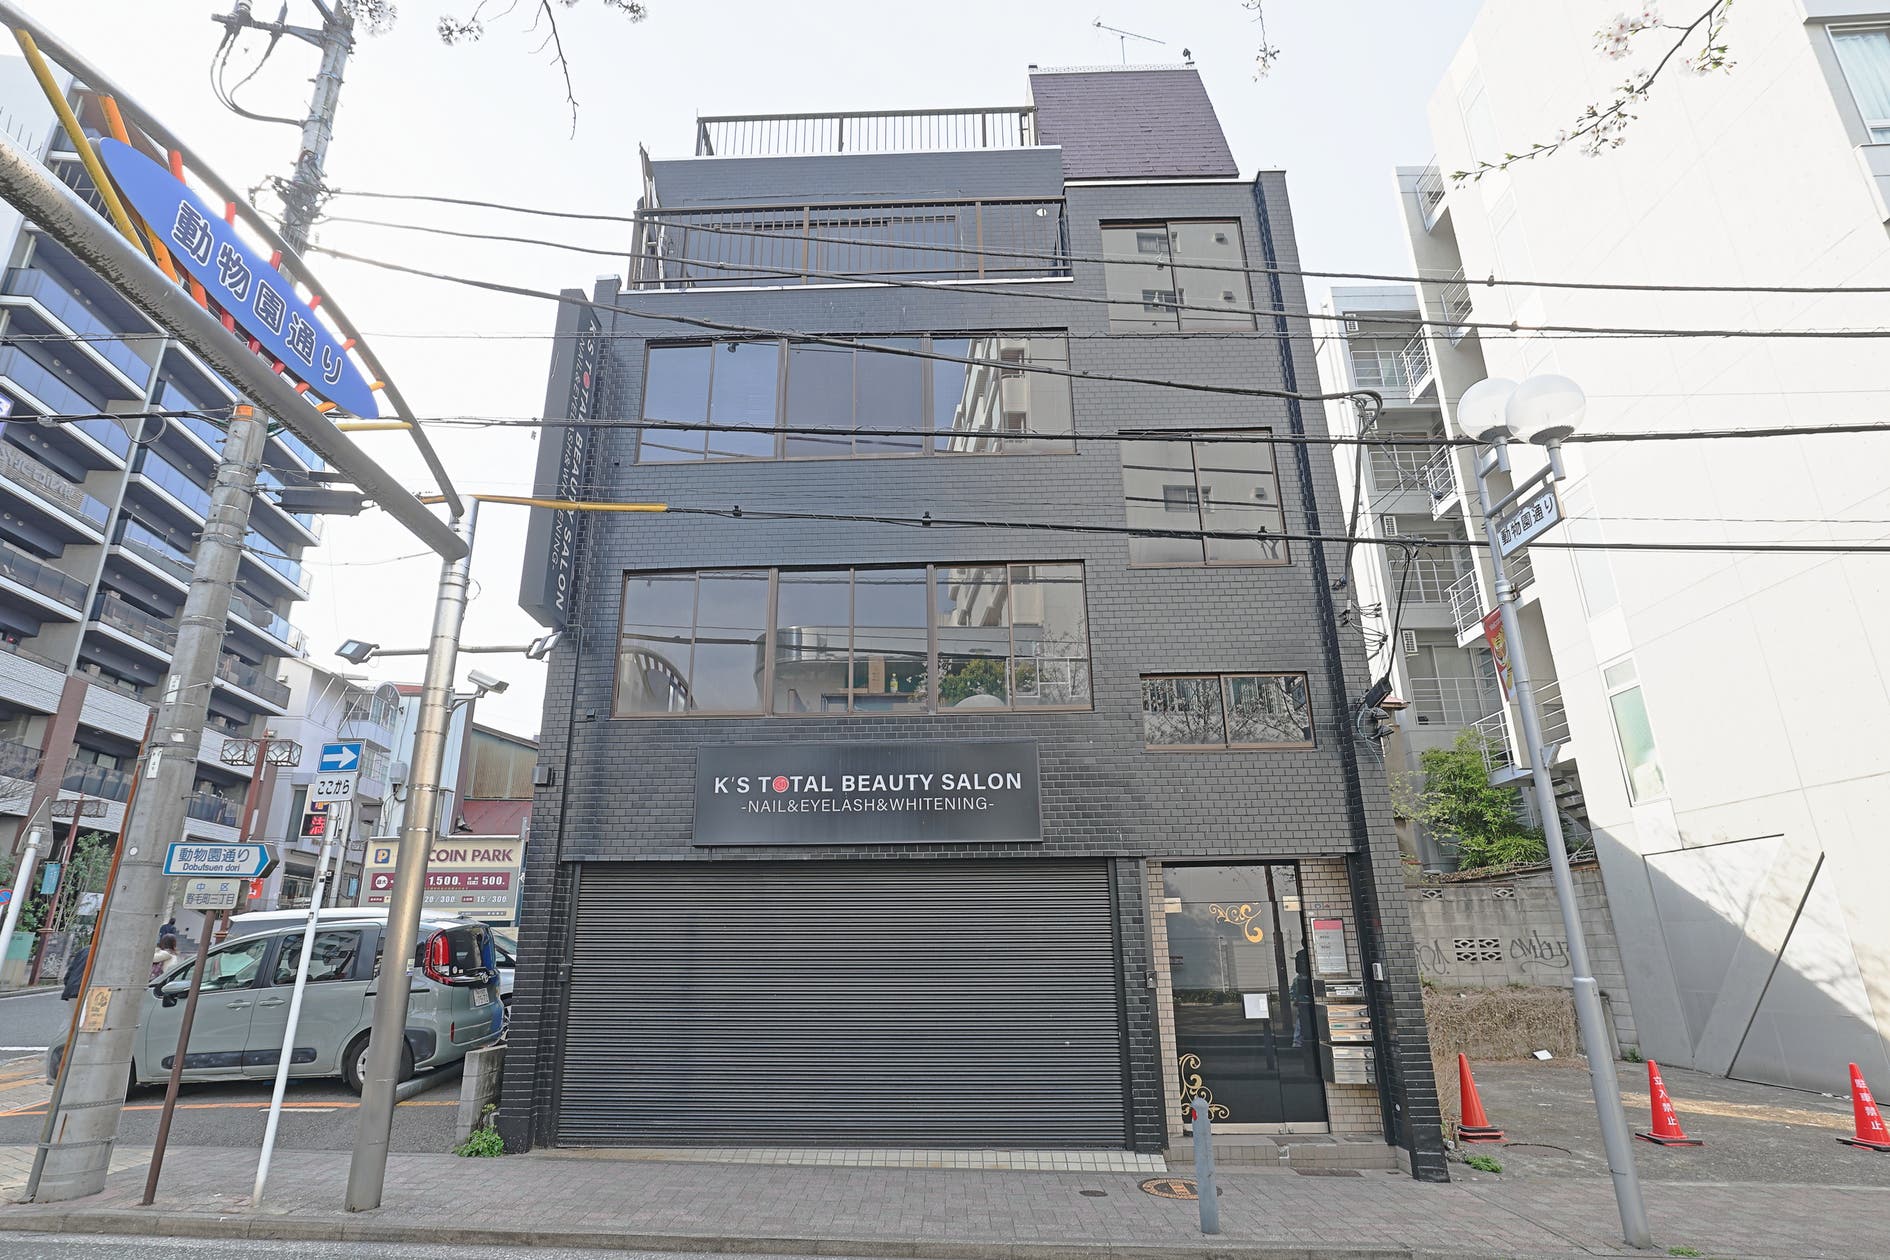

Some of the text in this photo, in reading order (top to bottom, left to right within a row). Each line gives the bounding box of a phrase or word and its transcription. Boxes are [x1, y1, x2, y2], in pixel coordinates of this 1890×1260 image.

[171, 200, 343, 386] 動物園通り
[1501, 496, 1553, 546] 動物園通り
[556, 526, 573, 611] SALON
[317, 779, 350, 795] ここから
[713, 772, 1022, 794] K'S TOTAL BEAUTY SALON
[177, 847, 250, 863] 動物園通り
[471, 848, 513, 862] PARK
[182, 862, 240, 872] Dobutsuen dori
[1652, 1076, 1678, 1126] 立入禁止
